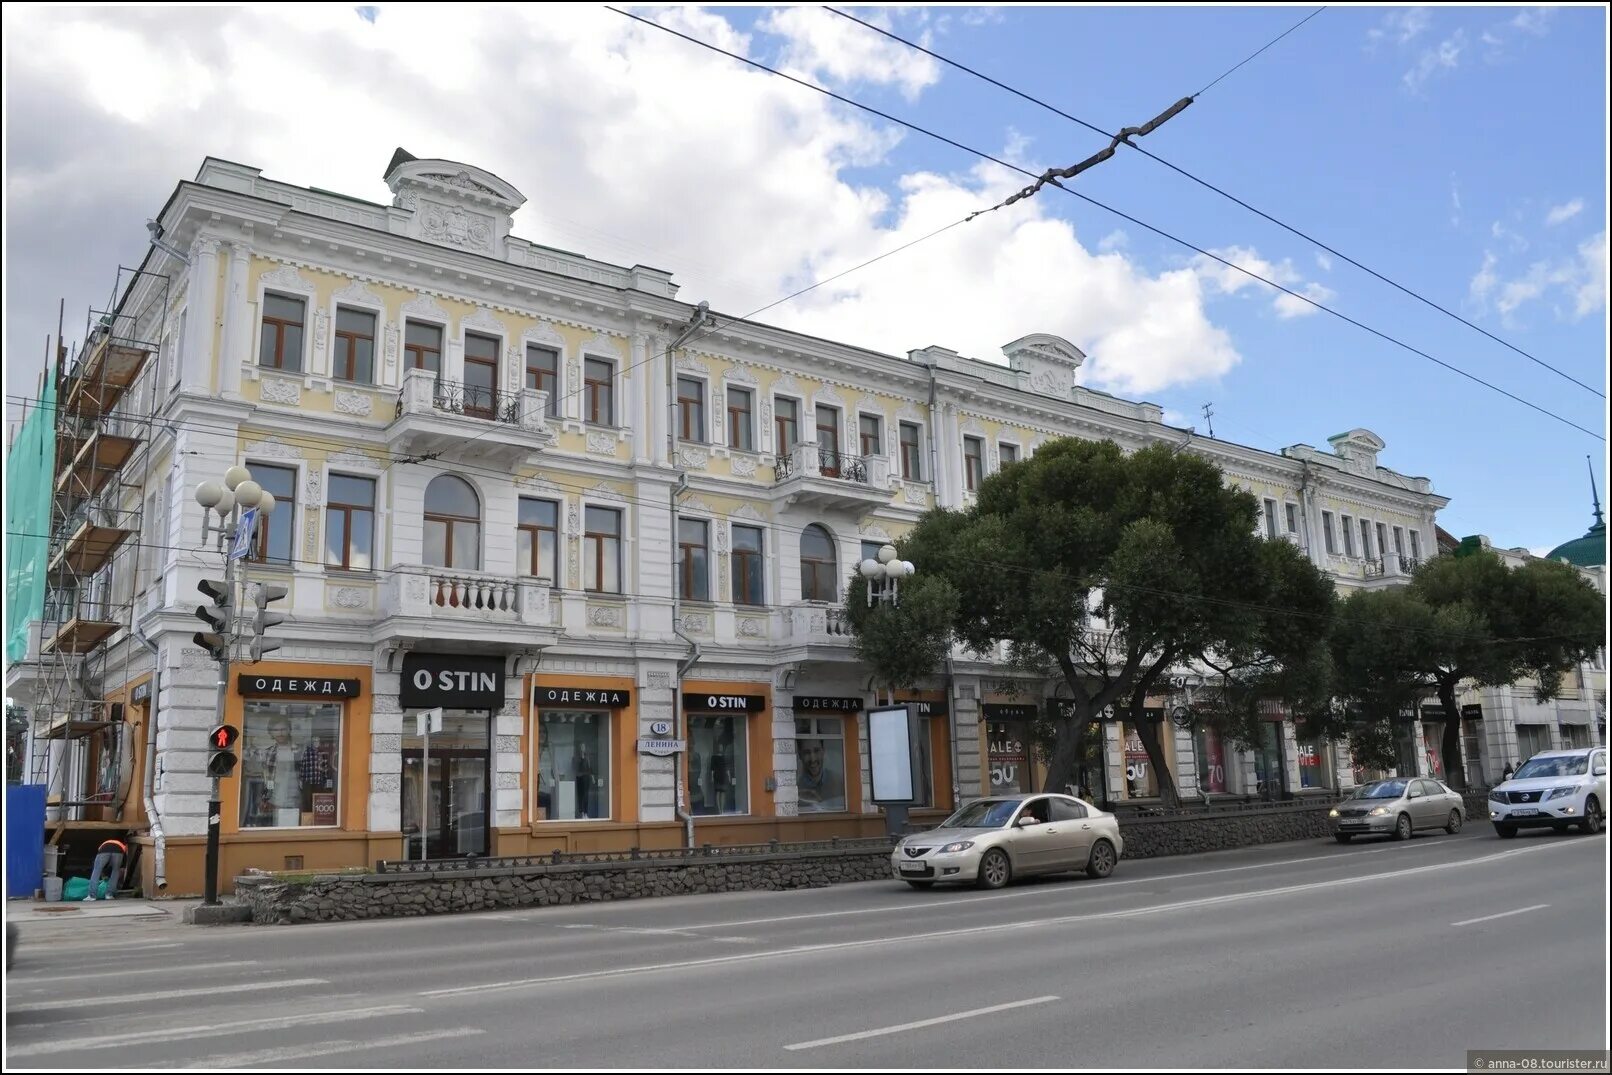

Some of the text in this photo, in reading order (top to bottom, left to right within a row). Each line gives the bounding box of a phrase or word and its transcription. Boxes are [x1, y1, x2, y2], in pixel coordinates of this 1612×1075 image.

[255, 678, 347, 694] ОДЕЖДА
[413, 669, 496, 692] O STIN
[548, 690, 620, 704] ОДЕЖДА
[707, 696, 747, 709] O STIN
[803, 699, 858, 710] ОДЕЖДА
[656, 723, 667, 732] 18
[315, 804, 335, 812] 1000
